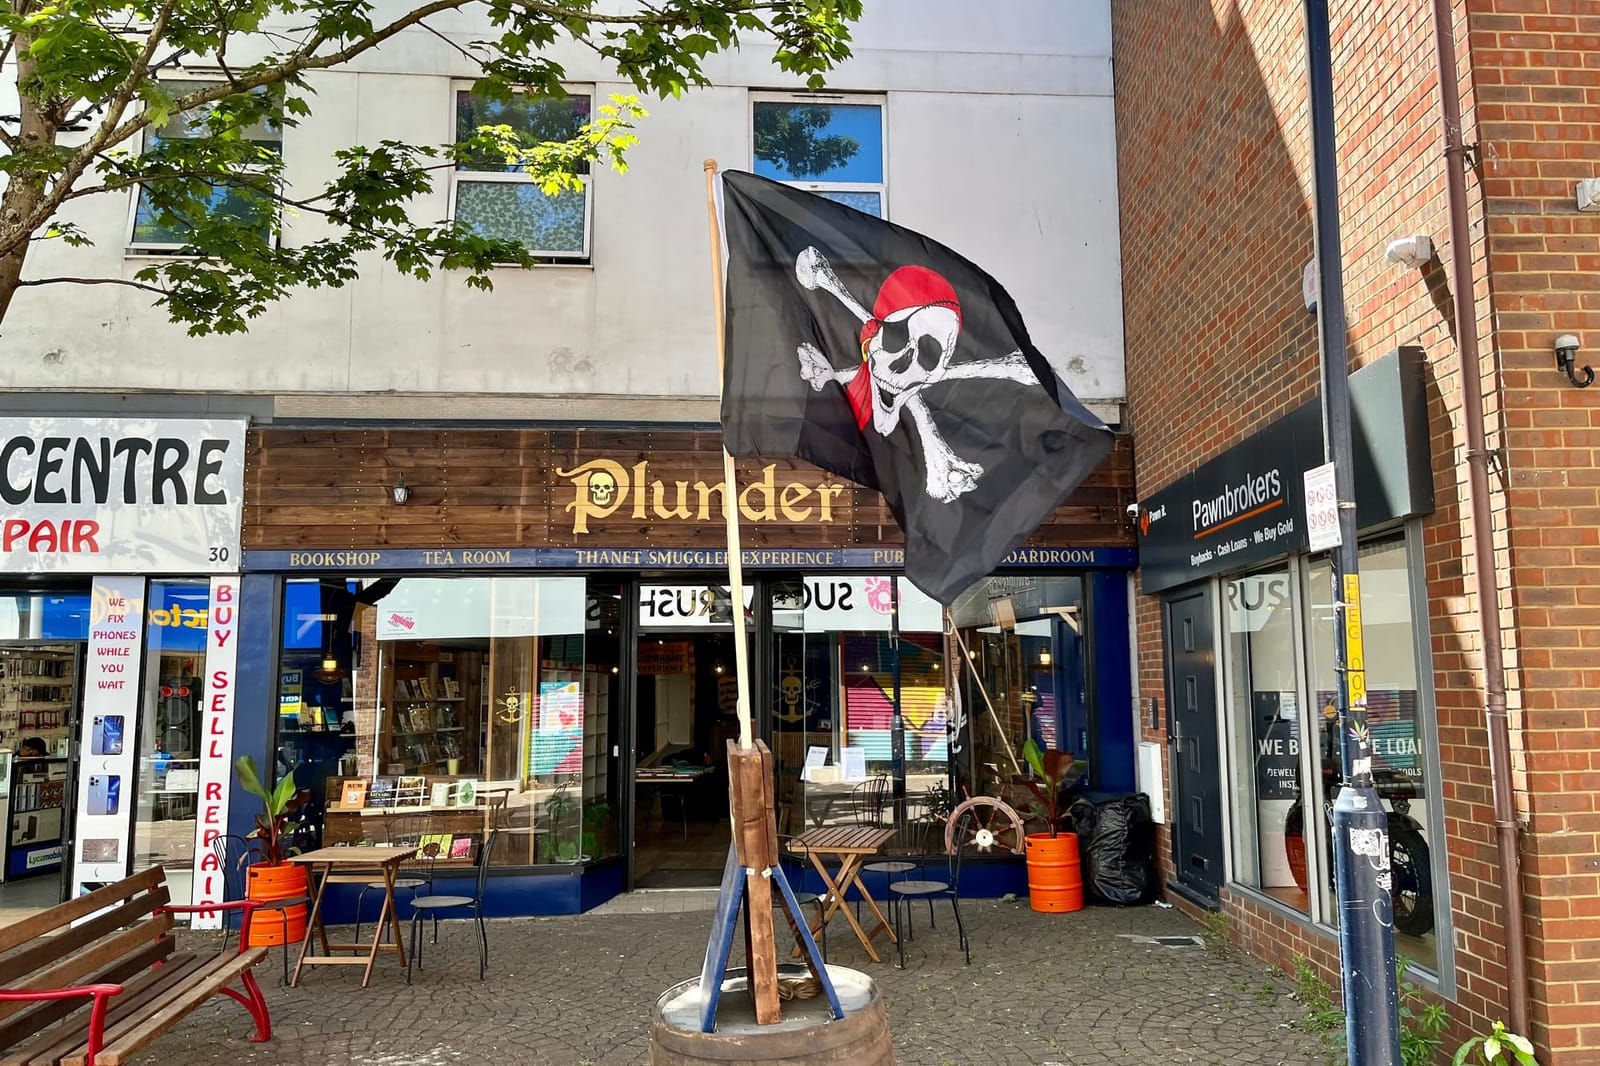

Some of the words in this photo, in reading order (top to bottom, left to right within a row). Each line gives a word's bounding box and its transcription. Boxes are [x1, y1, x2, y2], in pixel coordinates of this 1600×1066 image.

[0, 436, 230, 505] CENTRE
[555, 458, 844, 534] Plunder
[1192, 468, 1281, 531] Pawnbrokers
[1217, 541, 1231, 556] Cash
[1230, 537, 1248, 552] Loans
[1253, 529, 1264, 544] We
[1263, 527, 1276, 541] Buy
[1277, 518, 1294, 536] Gold
[208, 547, 229, 562] 30
[289, 552, 381, 567] BOOKSHOP
[423, 551, 454, 565] TEA
[462, 550, 511, 564] ROOM
[576, 550, 643, 565] THANET
[741, 551, 834, 565] EXPERIENCE
[1001, 550, 1095, 563] OARDROOM
[108, 597, 126, 607] WE
[107, 614, 125, 623] FIX
[214, 584, 233, 648] BUY
[93, 630, 136, 640] PHONES
[97, 647, 130, 656] WHILE
[101, 664, 124, 673] YOU
[98, 680, 125, 689] WAIT
[209, 671, 229, 758] SELL
[1258, 739, 1284, 755] WE
[1398, 767, 1422, 777] OOLS
[29, 849, 62, 864] Lycamobil
[199, 783, 223, 919] REPAIR
